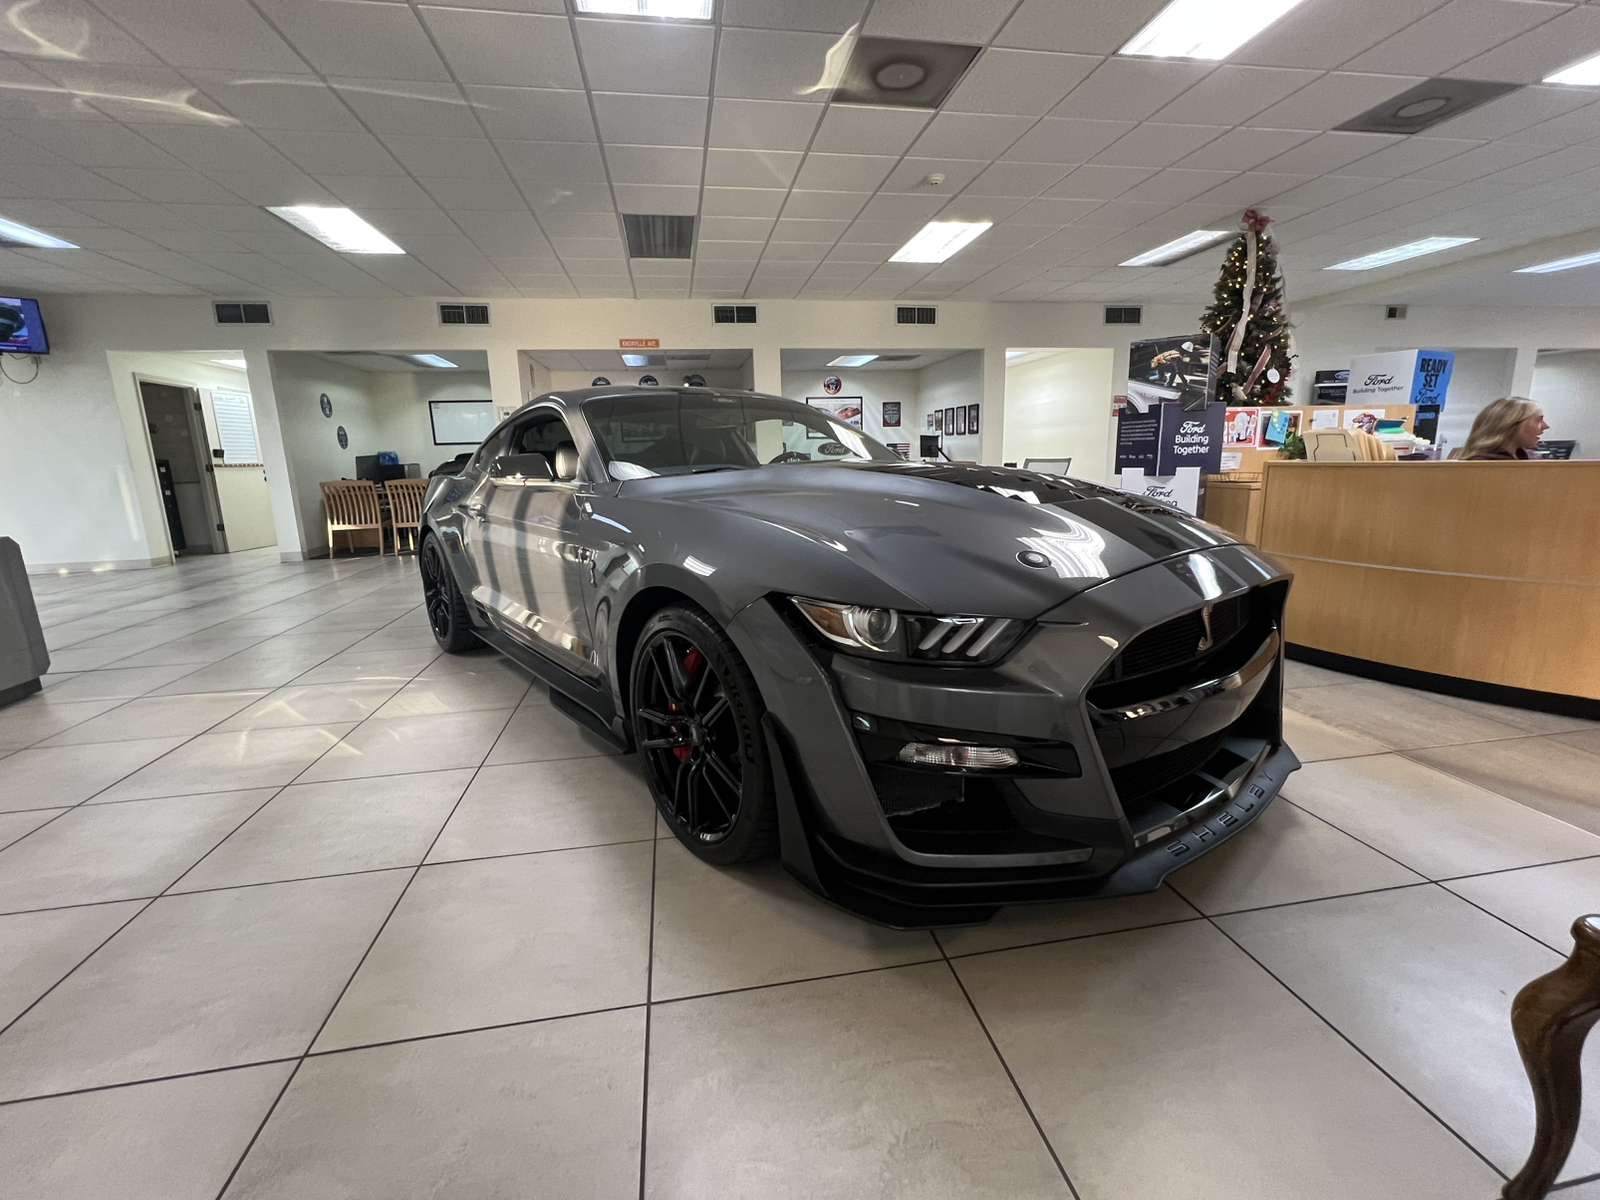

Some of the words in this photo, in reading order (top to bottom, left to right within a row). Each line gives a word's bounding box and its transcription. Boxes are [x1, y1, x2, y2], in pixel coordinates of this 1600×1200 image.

[1420, 358, 1448, 373] READY
[1364, 374, 1394, 386] Ford
[1423, 374, 1439, 388] SET
[1414, 388, 1440, 404] Ford
[1180, 421, 1206, 433] Ford
[1175, 435, 1209, 445] Building
[1173, 445, 1210, 456] Together
[1143, 485, 1173, 498] Ford
